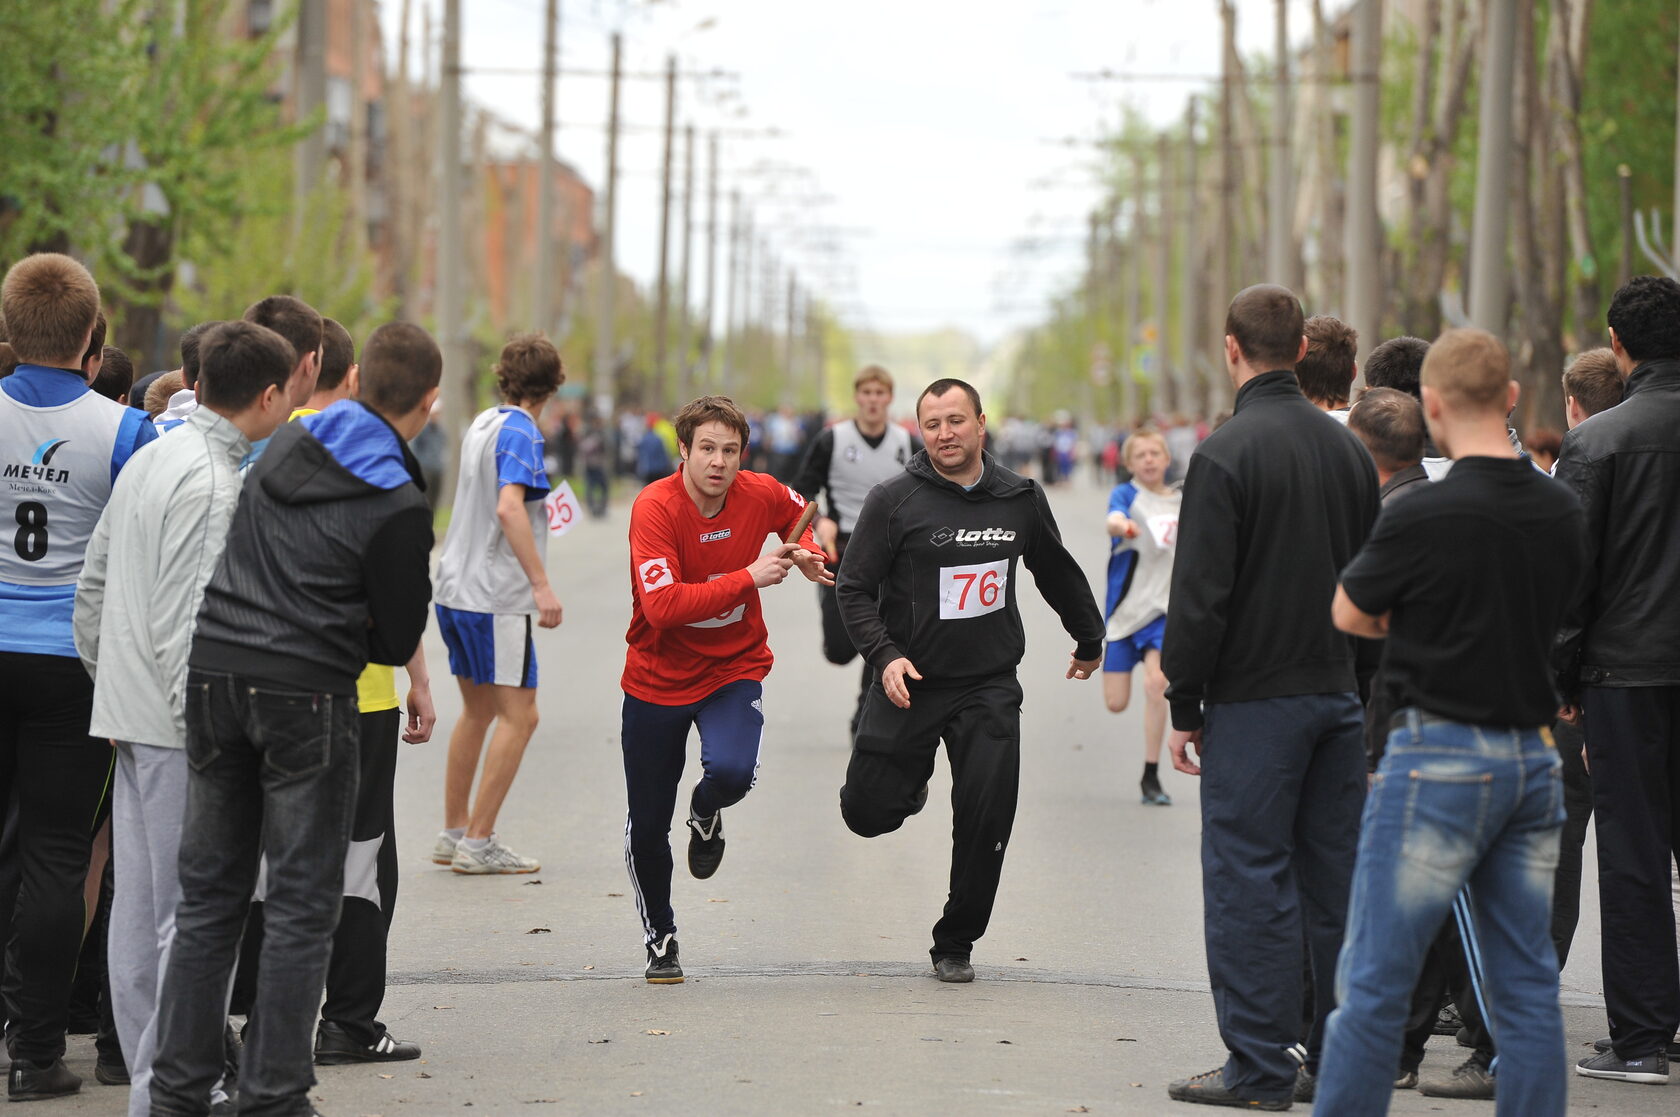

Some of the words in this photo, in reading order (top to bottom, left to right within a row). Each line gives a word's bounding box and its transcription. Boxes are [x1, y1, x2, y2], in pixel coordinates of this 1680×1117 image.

[3, 464, 70, 484] МЕЧЕЛ
[14, 501, 49, 562] 8
[546, 493, 573, 531] 25
[953, 569, 999, 611] 76
